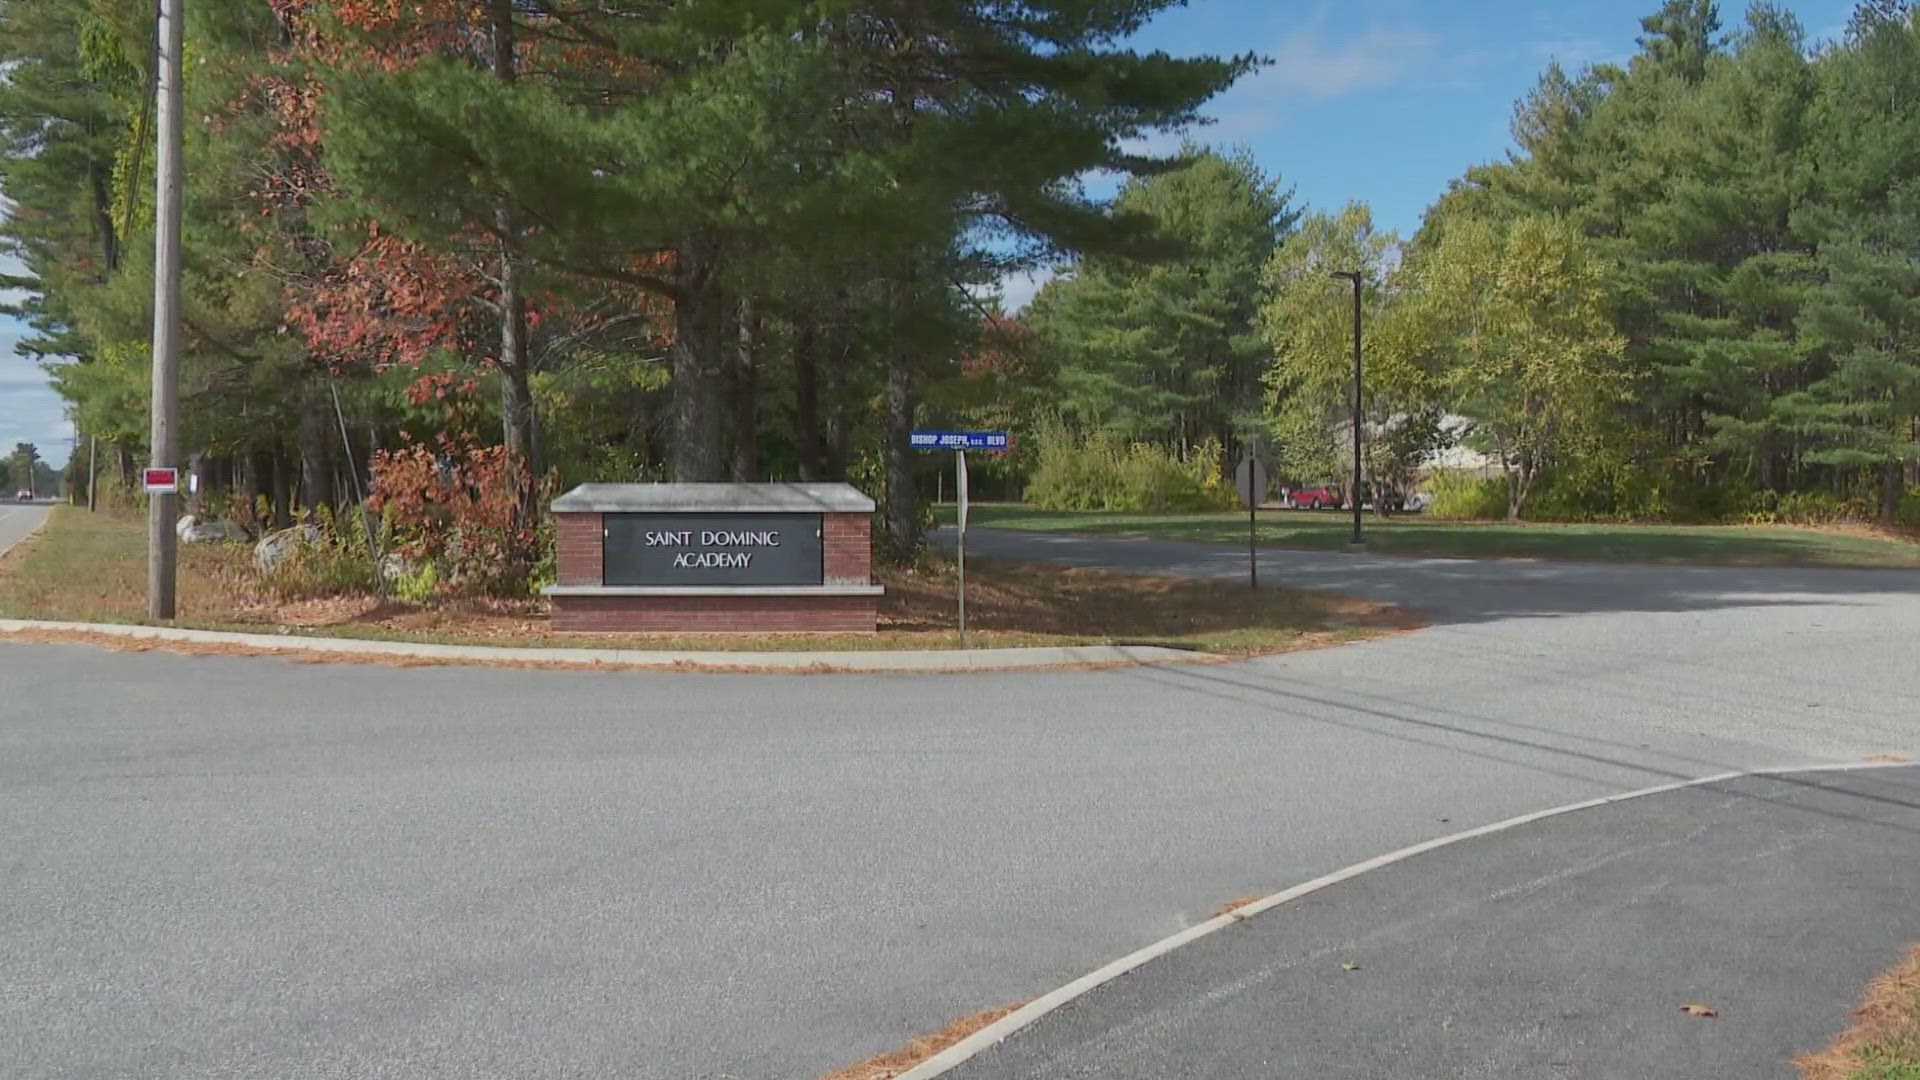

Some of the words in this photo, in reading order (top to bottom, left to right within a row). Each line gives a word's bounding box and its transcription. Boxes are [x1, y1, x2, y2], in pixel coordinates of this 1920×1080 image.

[911, 434, 938, 445] BISHOP
[939, 434, 969, 446] JOSEPH,
[986, 435, 1006, 446] BLVD
[645, 531, 692, 546] SAINT
[701, 531, 779, 546] DOMINIC
[673, 552, 752, 567] ACADEMY
